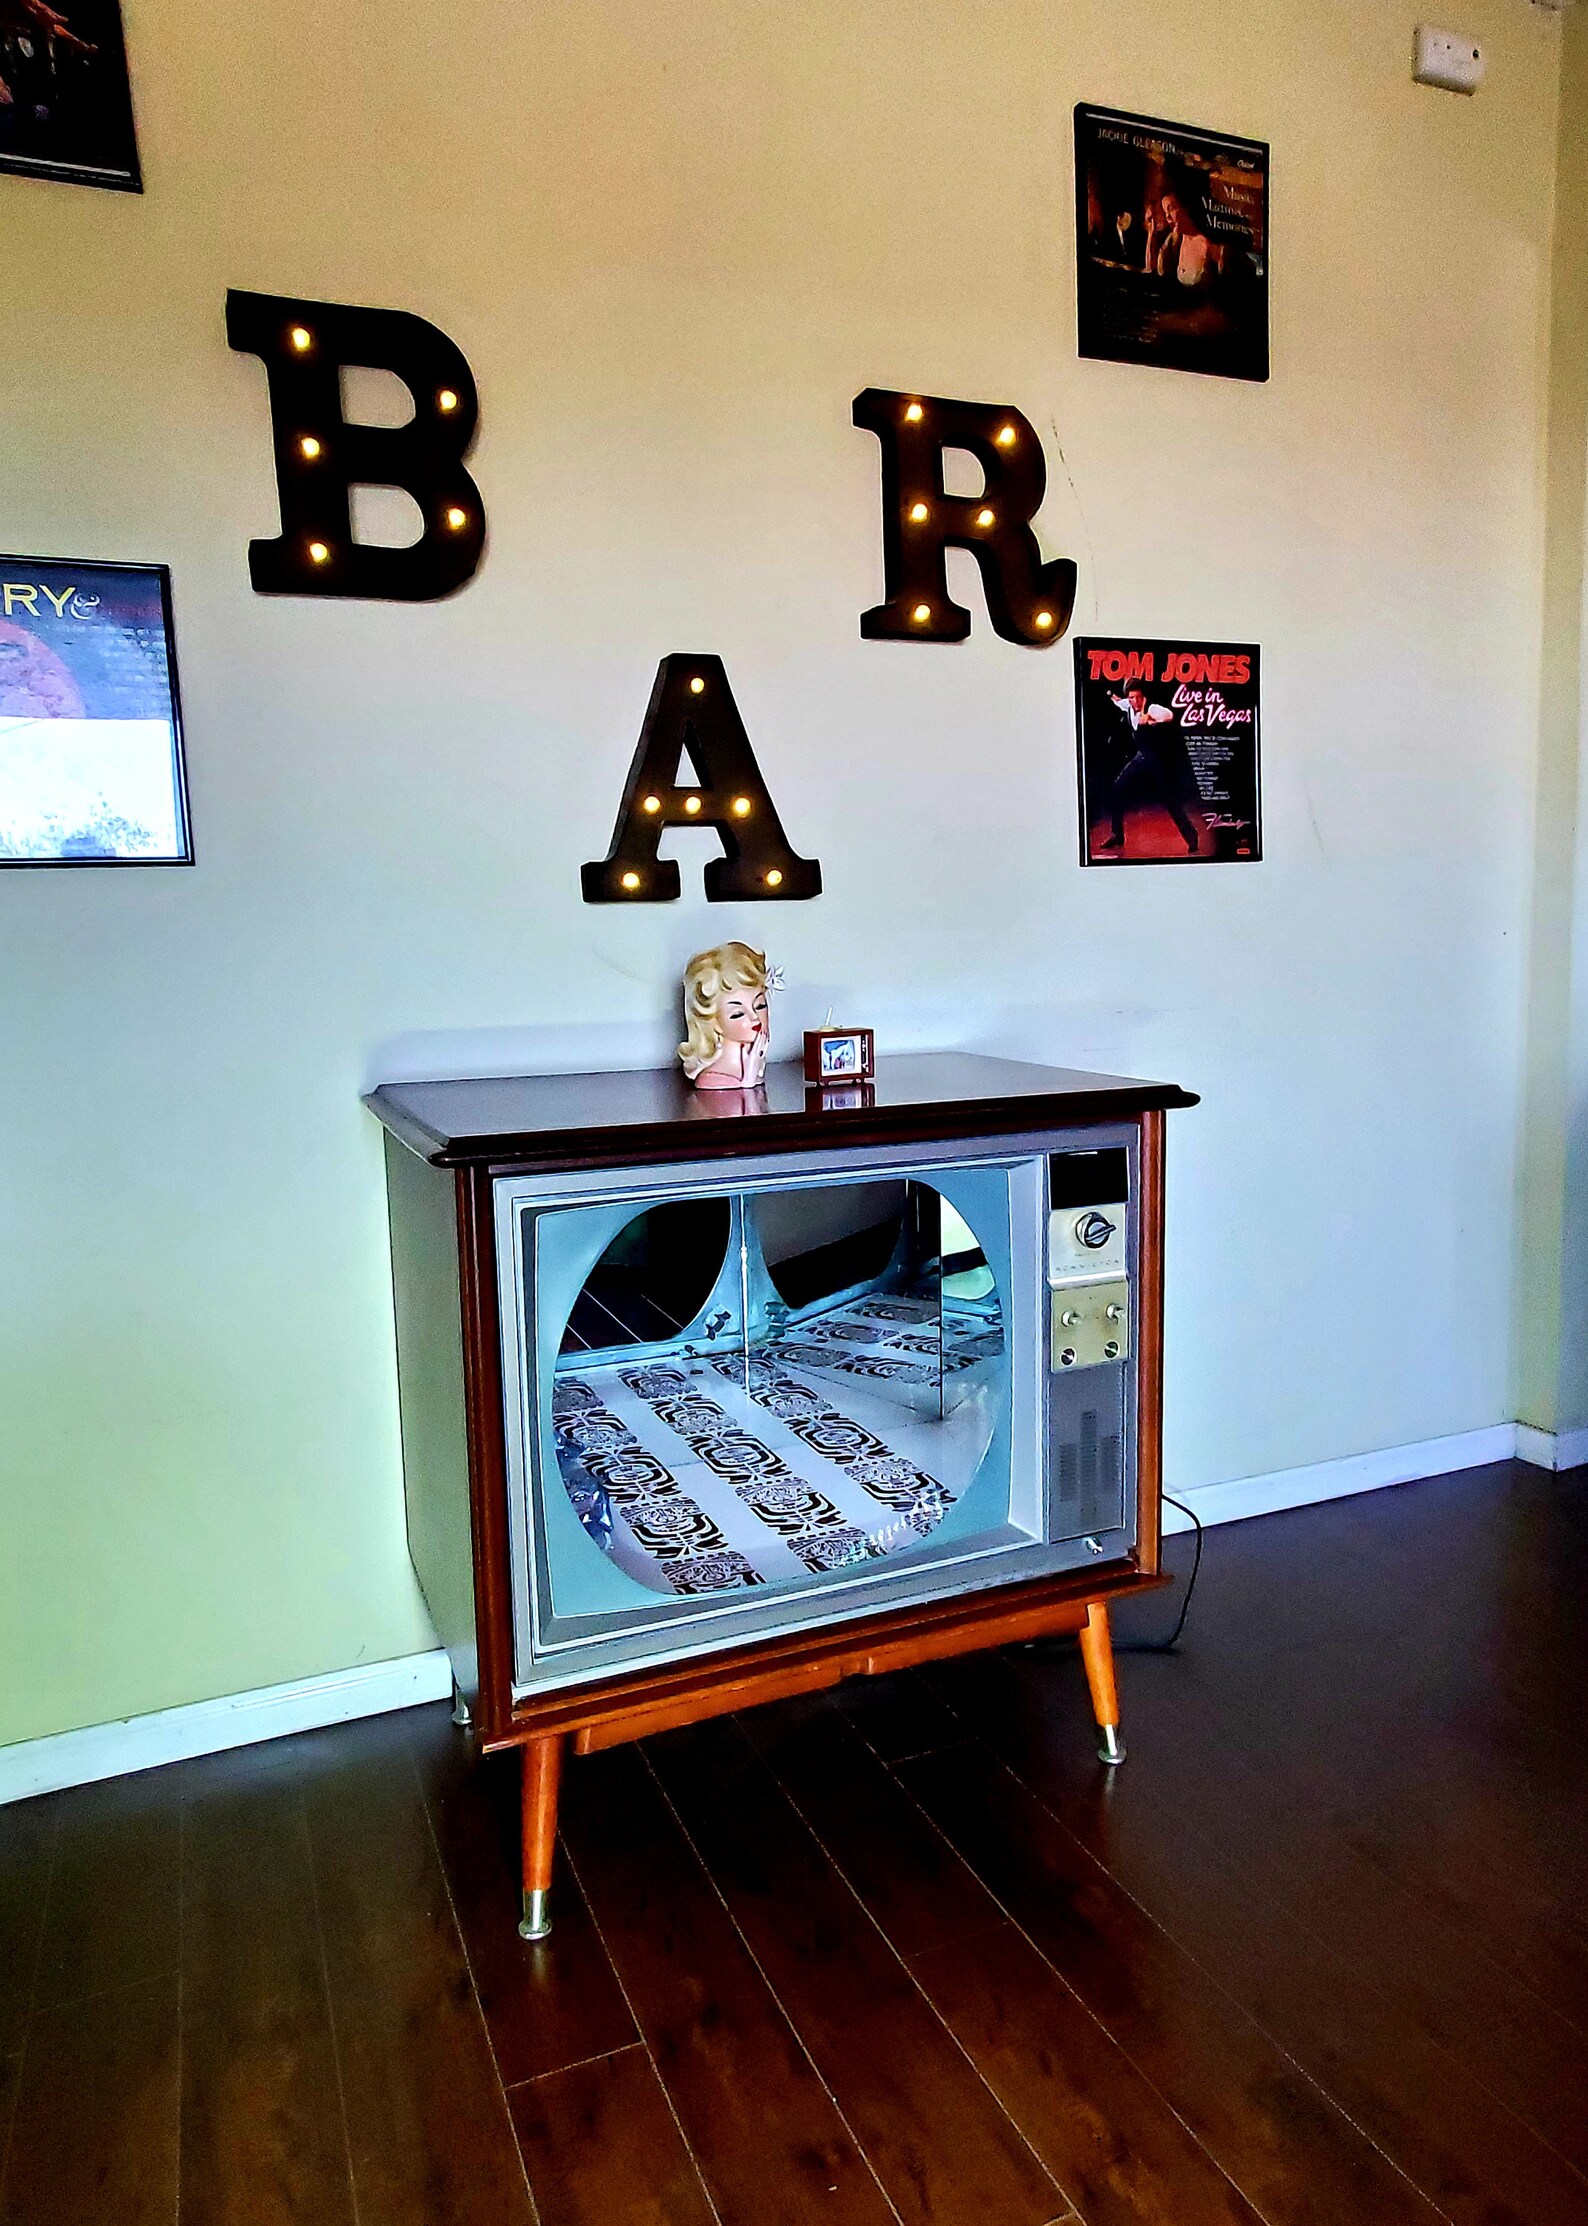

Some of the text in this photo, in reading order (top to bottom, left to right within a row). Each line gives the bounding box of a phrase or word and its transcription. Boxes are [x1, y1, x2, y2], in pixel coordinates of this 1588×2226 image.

[1087, 650, 1251, 684] TOM JONES
[1171, 684, 1224, 708] Live in
[1180, 703, 1252, 730] Las Vegas
